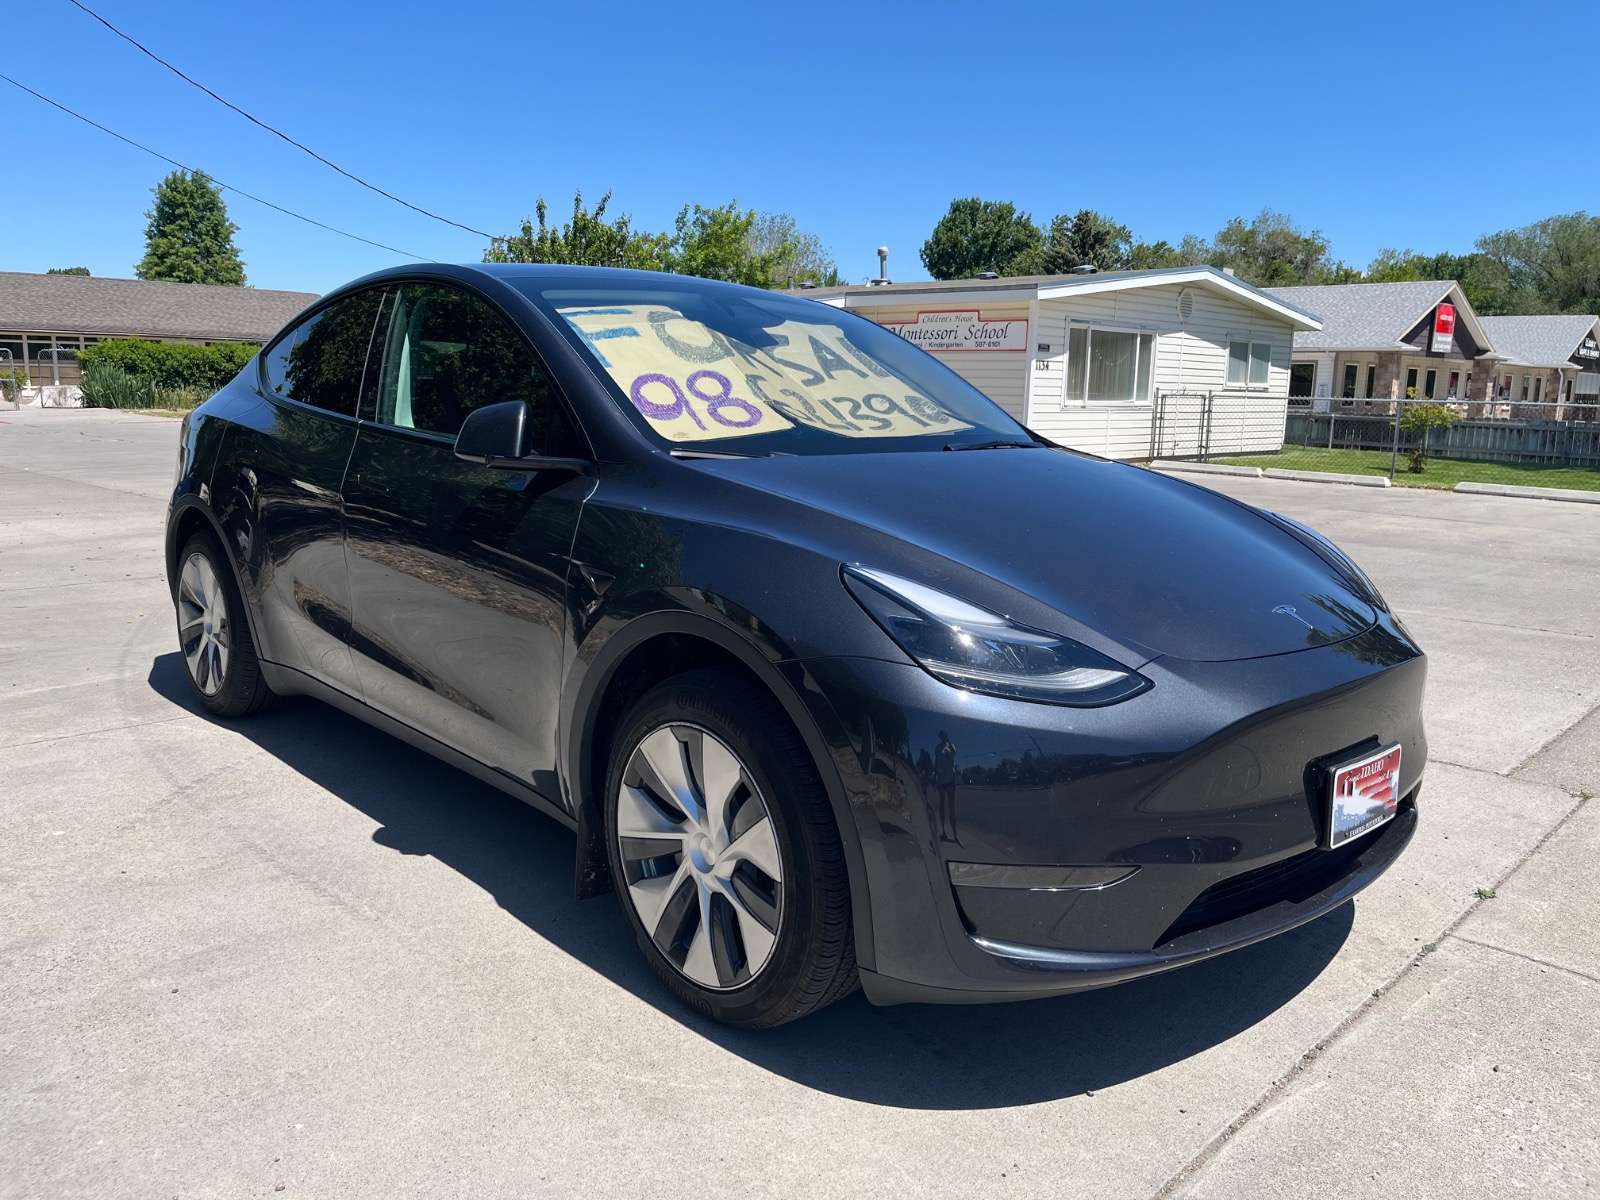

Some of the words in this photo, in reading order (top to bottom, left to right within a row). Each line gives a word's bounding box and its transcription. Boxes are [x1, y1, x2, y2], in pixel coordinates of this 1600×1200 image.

[922, 314, 952, 324] Children's
[954, 314, 974, 323] House
[890, 324, 959, 341] Montessori
[964, 322, 1011, 340] School
[928, 341, 963, 349] Kindergarten
[760, 333, 891, 387] SAL
[1035, 360, 1049, 371] 1134
[1360, 759, 1384, 778] IDAHO
